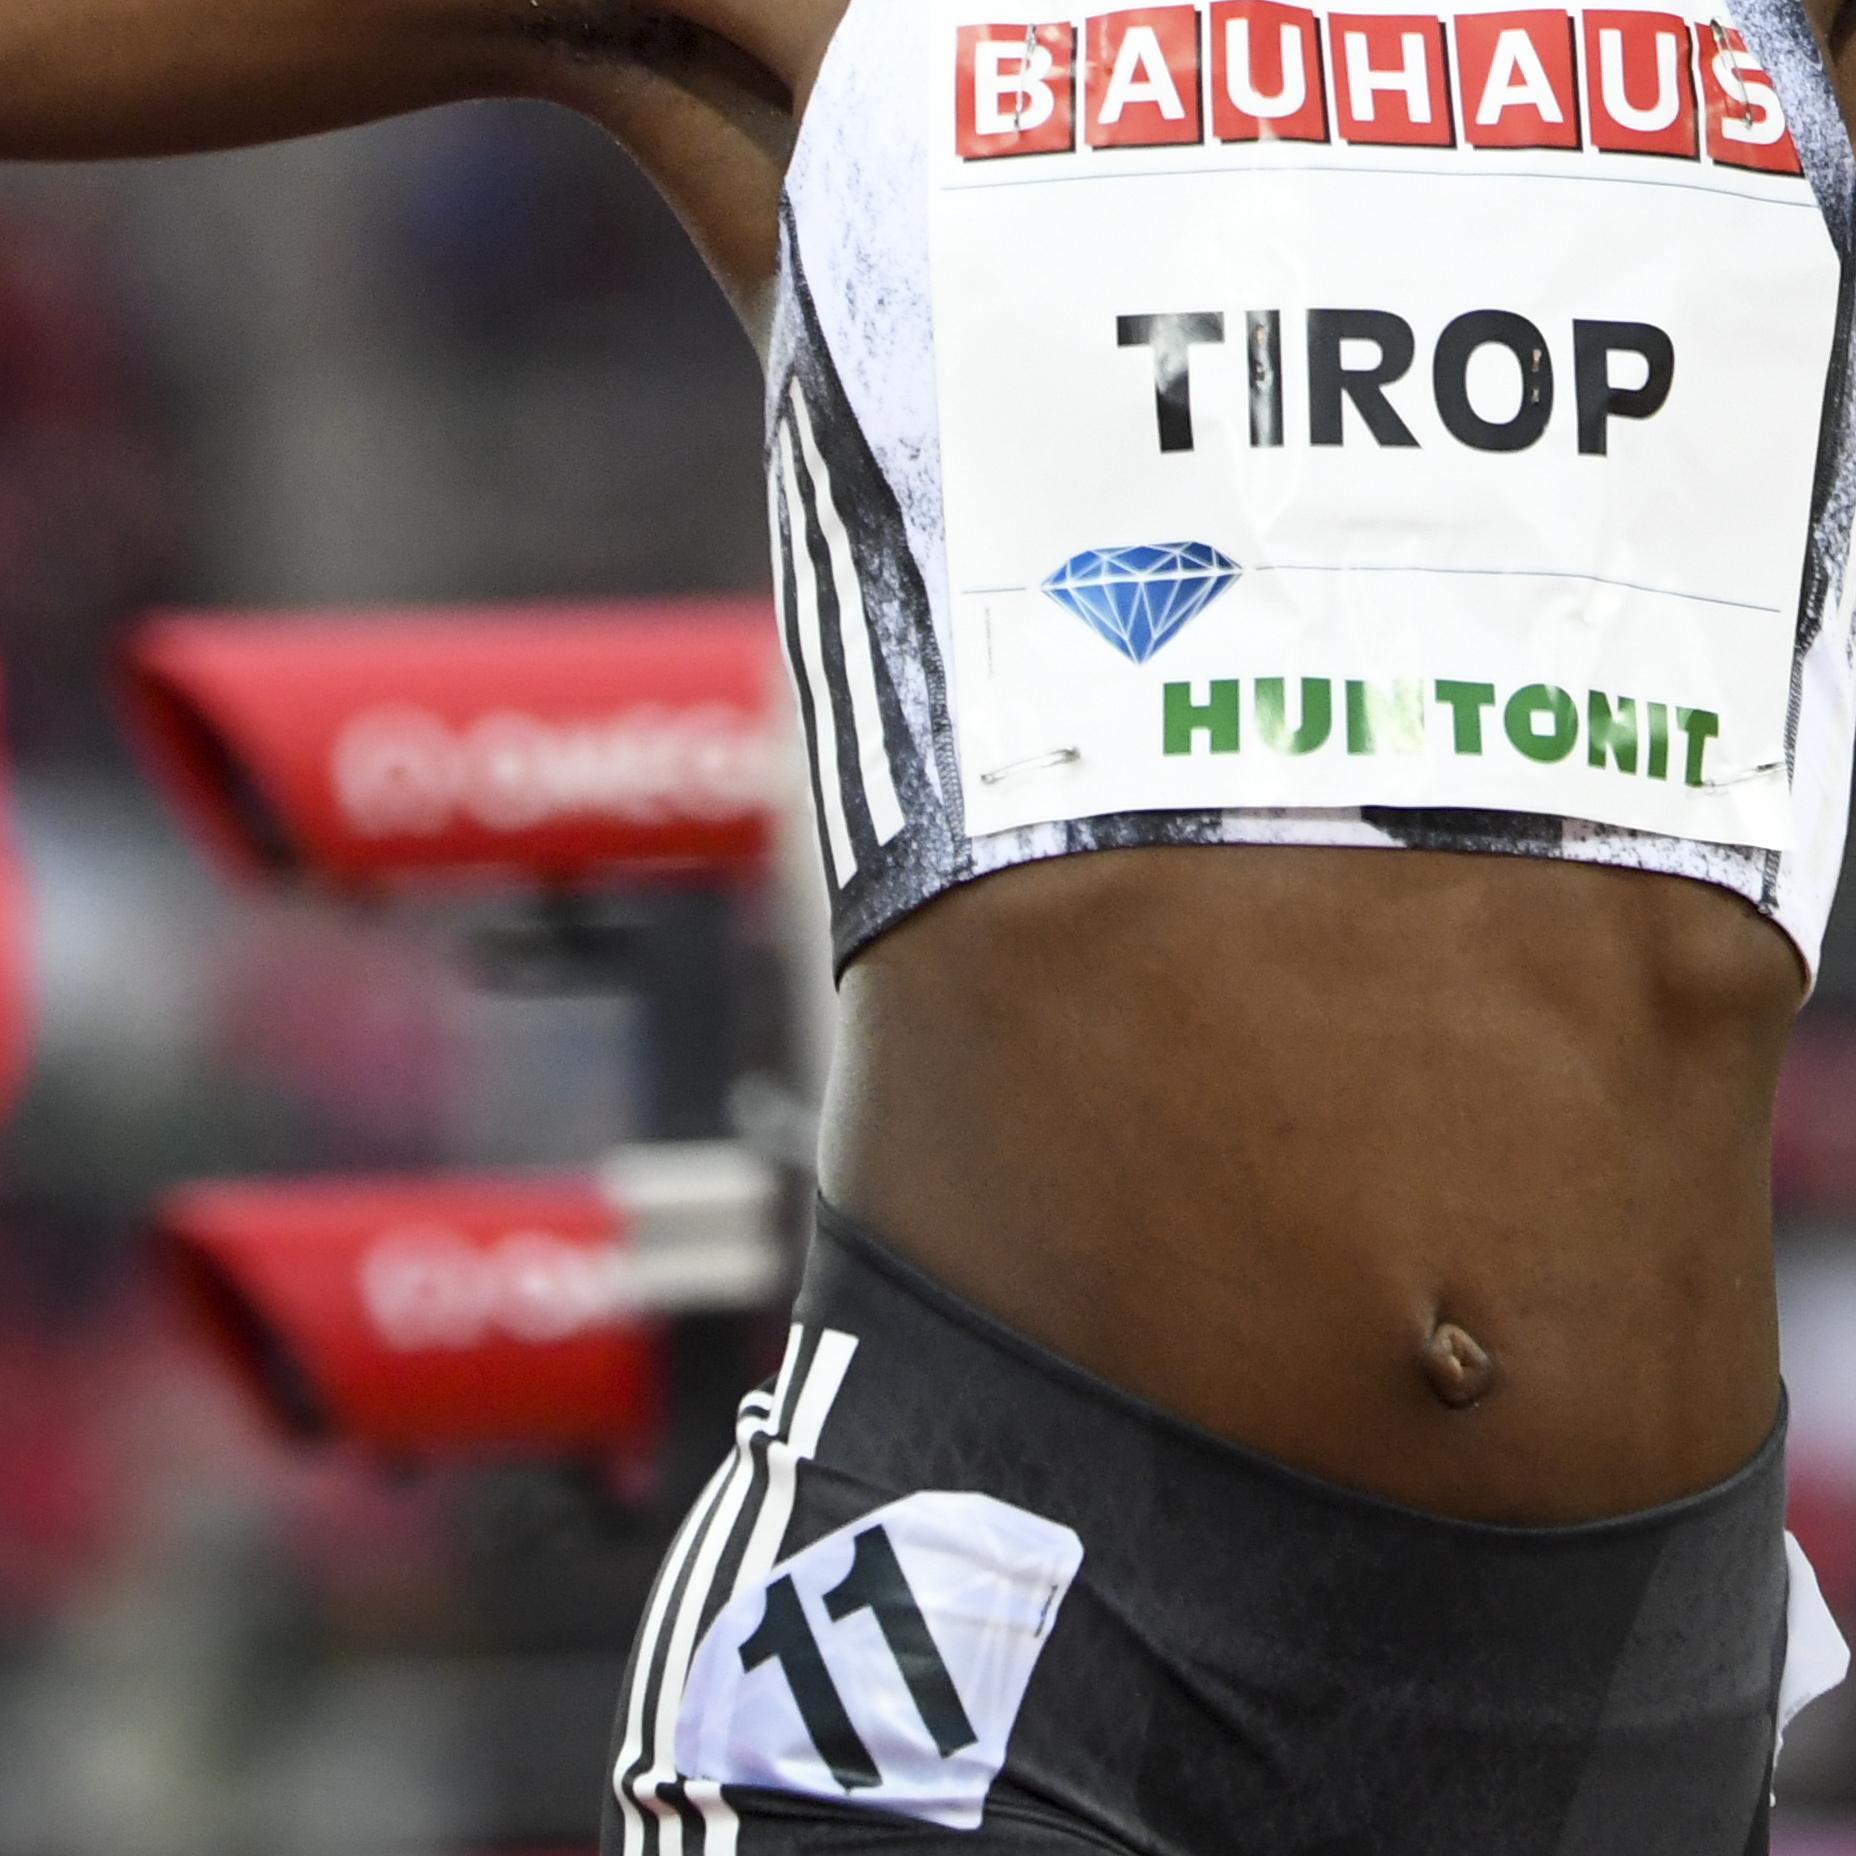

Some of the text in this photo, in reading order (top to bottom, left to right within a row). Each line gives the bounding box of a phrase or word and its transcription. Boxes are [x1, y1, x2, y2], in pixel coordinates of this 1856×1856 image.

[972, 14, 1787, 146] BAUHAUS
[1115, 308, 1676, 457] TIROP
[1162, 676, 1719, 788] HUNTONIT
[738, 1523, 979, 1793] 11
